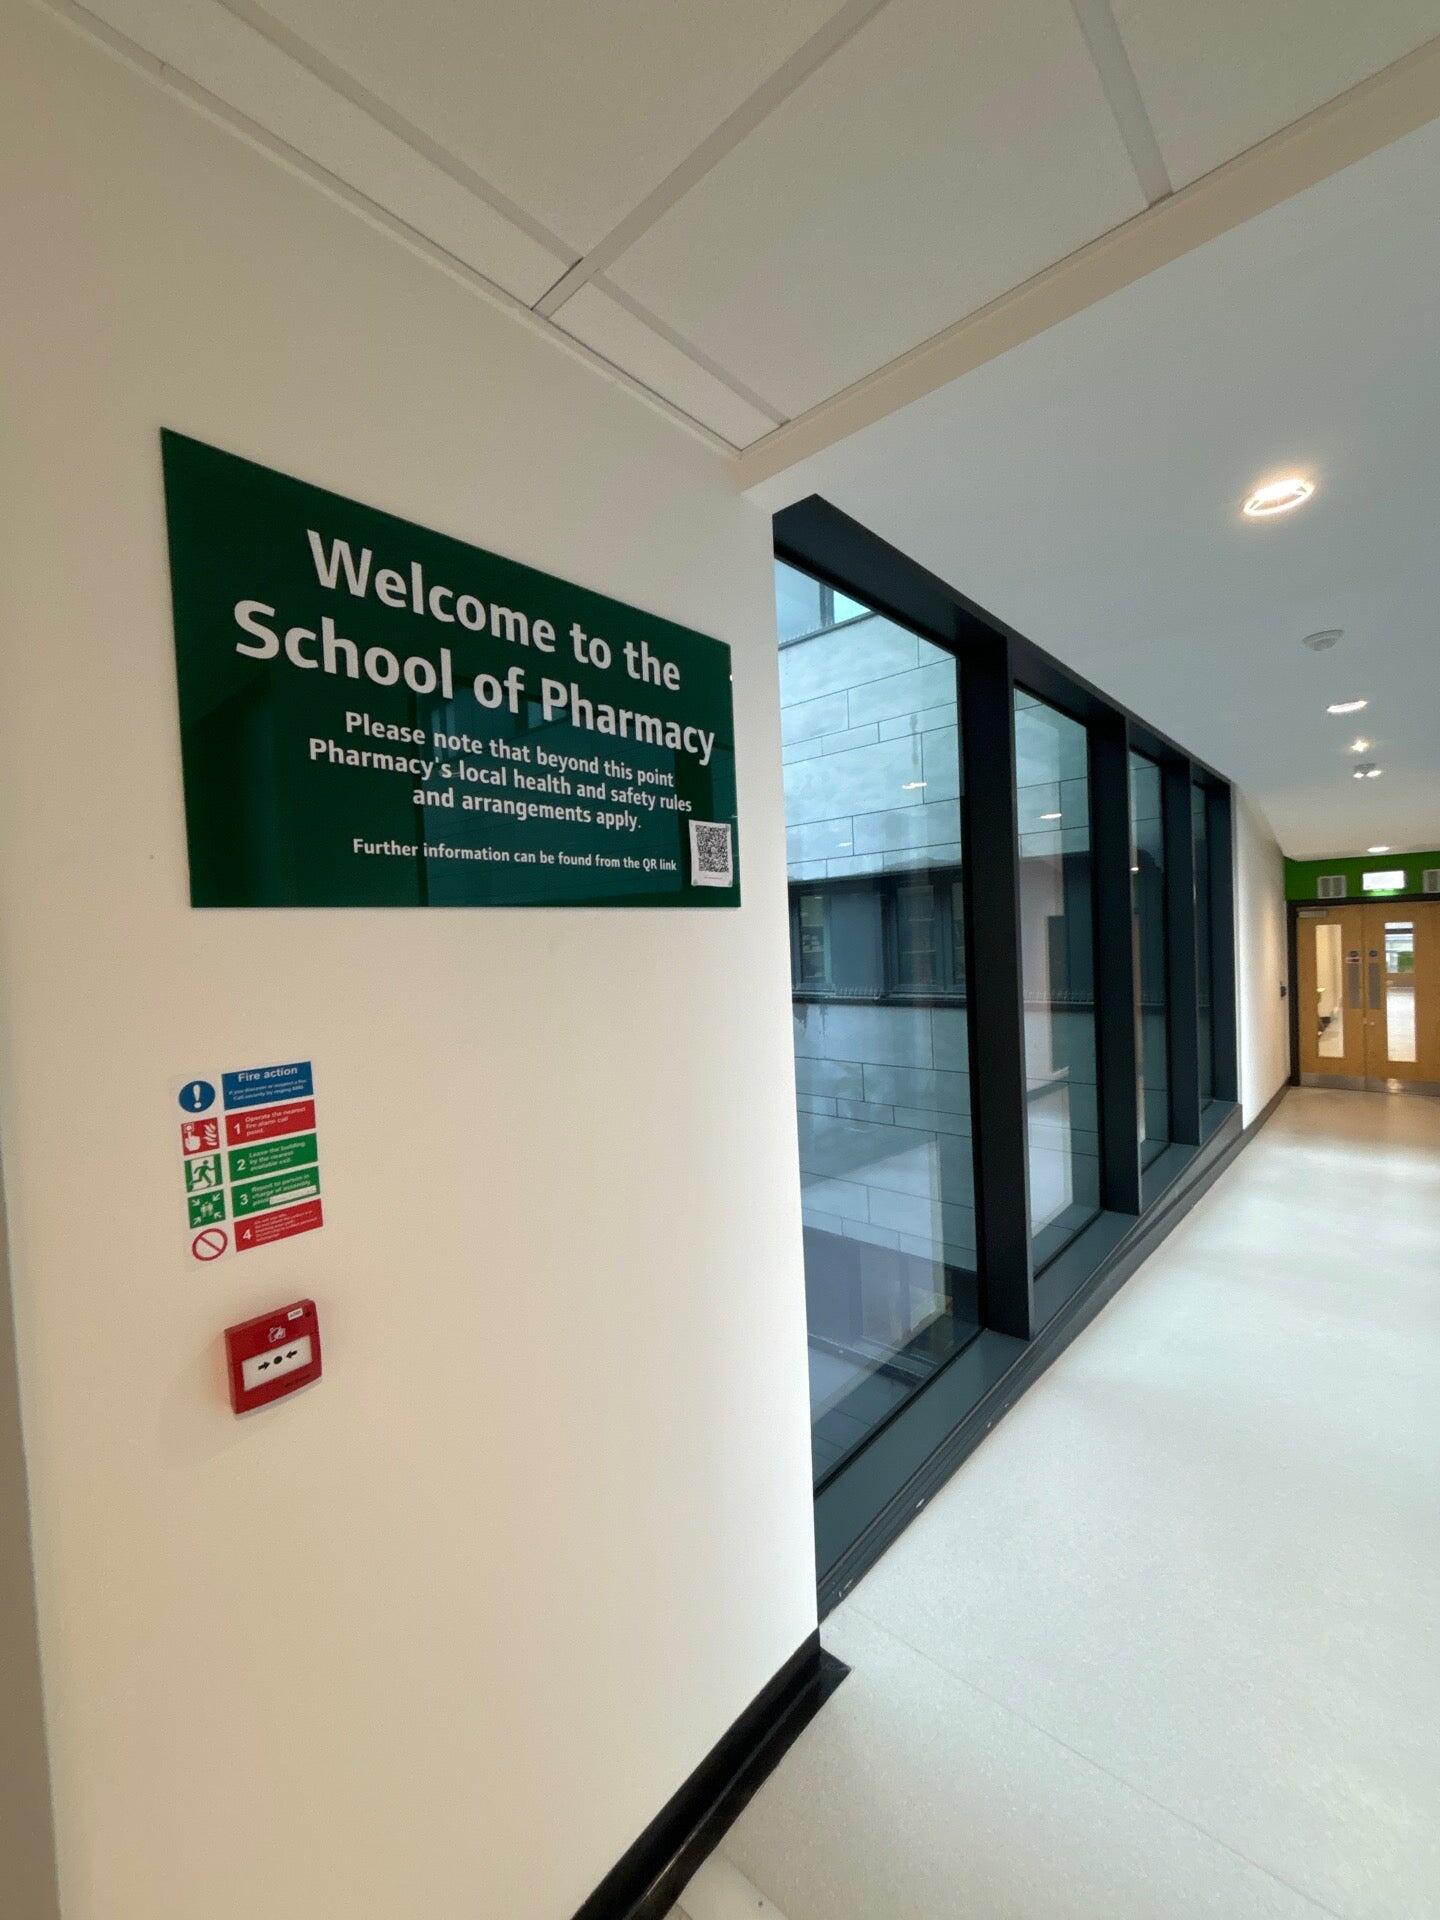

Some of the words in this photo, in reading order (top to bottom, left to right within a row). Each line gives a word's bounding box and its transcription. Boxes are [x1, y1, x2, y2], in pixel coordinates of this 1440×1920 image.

[306, 528, 556, 653] Welcome
[569, 622, 612, 670] to
[623, 640, 681, 691] the
[234, 599, 454, 700] School
[473, 666, 525, 714] of
[541, 677, 715, 767] Pharmacy
[345, 711, 426, 745] Please
[433, 732, 483, 755] note
[488, 738, 532, 764] that
[536, 745, 599, 775] beyond
[603, 759, 634, 781] this
[636, 769, 675, 788] point
[309, 737, 453, 781] Pharmacy's
[459, 759, 507, 787] local
[513, 768, 572, 796] health
[576, 782, 606, 801] and
[610, 786, 656, 812] safety
[659, 793, 692, 813] rules
[412, 786, 455, 809] and
[461, 794, 592, 823] arrangements
[595, 809, 643, 833] apply.
[352, 838, 419, 857] Further
[422, 842, 510, 862] information
[513, 852, 537, 864] can
[539, 849, 555, 865] be
[557, 851, 593, 867] found
[594, 854, 621, 868] from
[622, 855, 641, 869] the
[642, 857, 658, 872] QR
[659, 858, 678, 871] link
[238, 1072, 261, 1083] Fire
[263, 1067, 298, 1079] action
[233, 1122, 241, 1136] 1
[236, 1158, 246, 1171] 2
[239, 1193, 249, 1206] 3
[242, 1228, 252, 1240] 4
